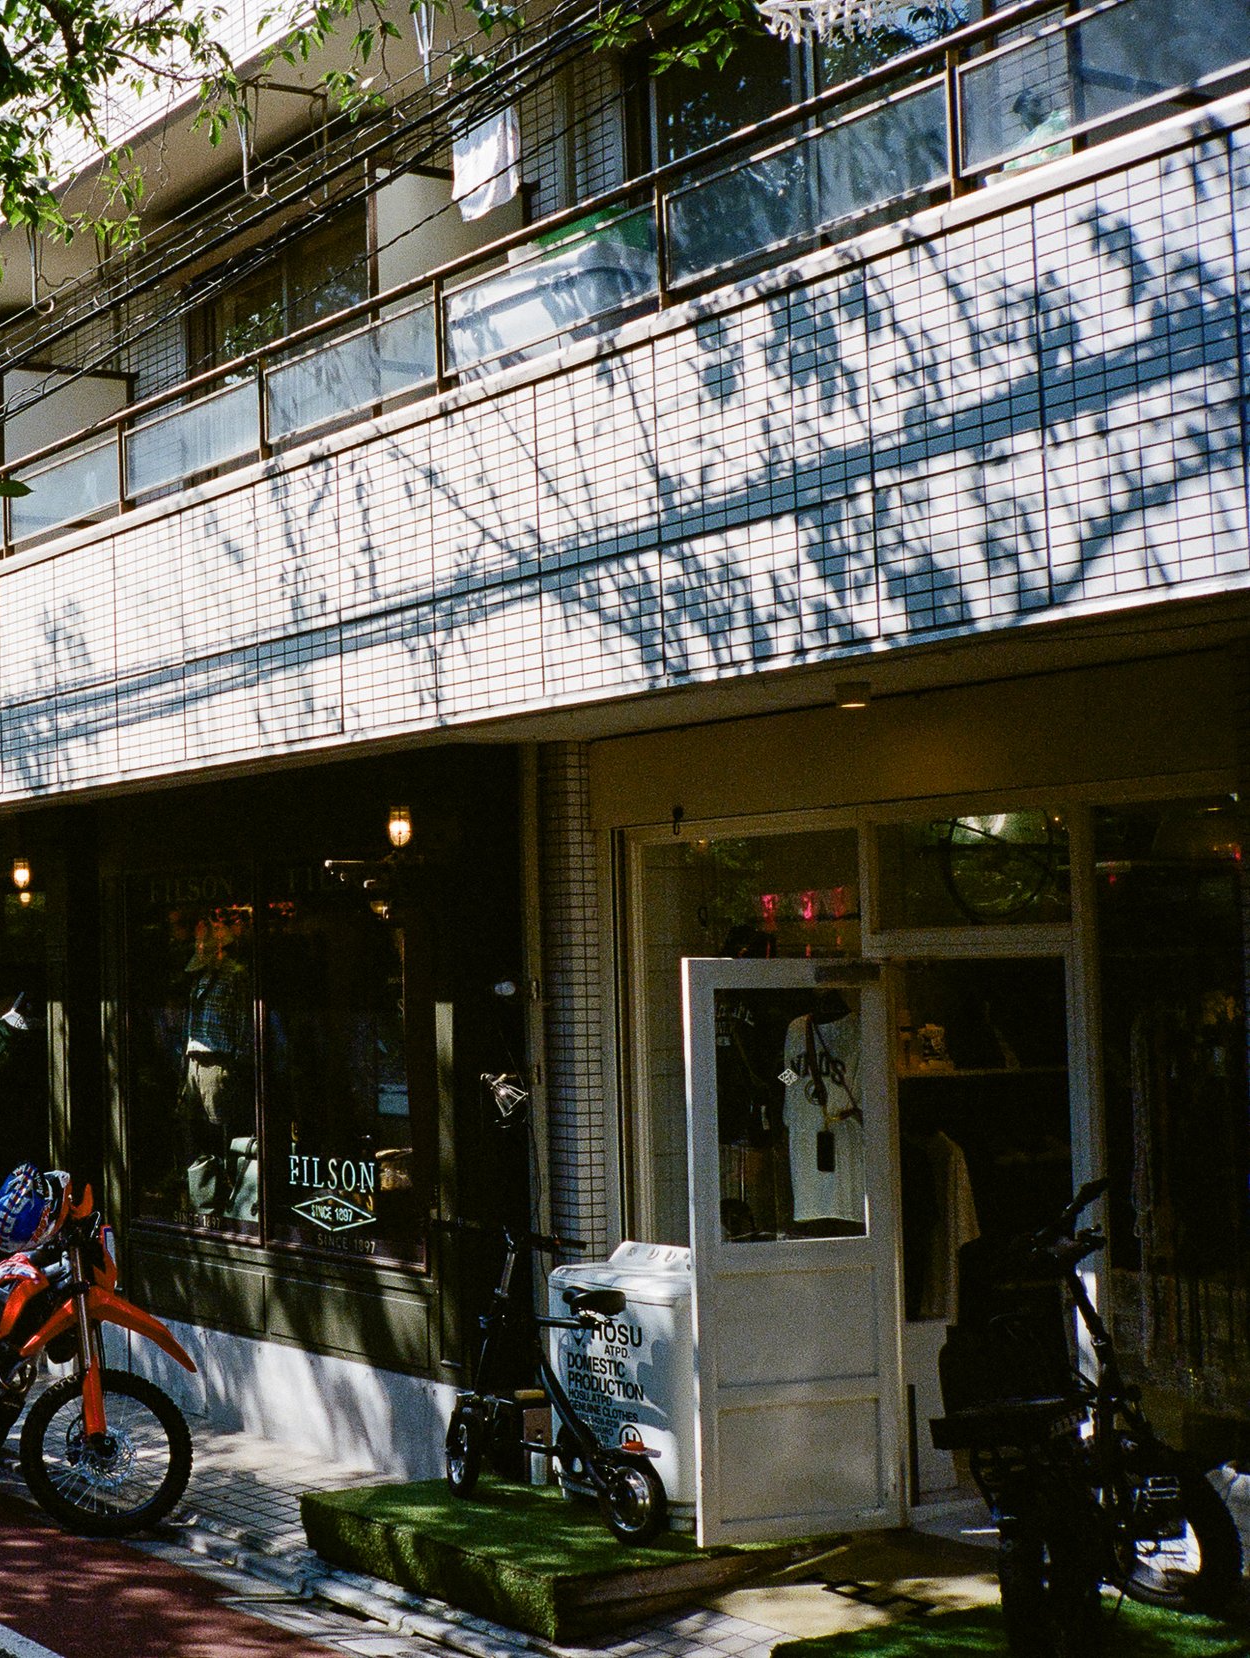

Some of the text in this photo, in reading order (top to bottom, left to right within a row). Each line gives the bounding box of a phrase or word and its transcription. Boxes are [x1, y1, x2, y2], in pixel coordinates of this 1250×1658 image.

[289, 1155, 375, 1193] FILSON
[310, 1204, 354, 1223] SINCE 1897
[317, 1232, 377, 1255] SINCE 1897
[590, 1321, 643, 1348] HOSU
[604, 1343, 631, 1360] ATPD.
[567, 1351, 627, 1379] DOMESTIC
[567, 1370, 644, 1402] PRODUCTION
[602, 1406, 639, 1424] CLOTHES
